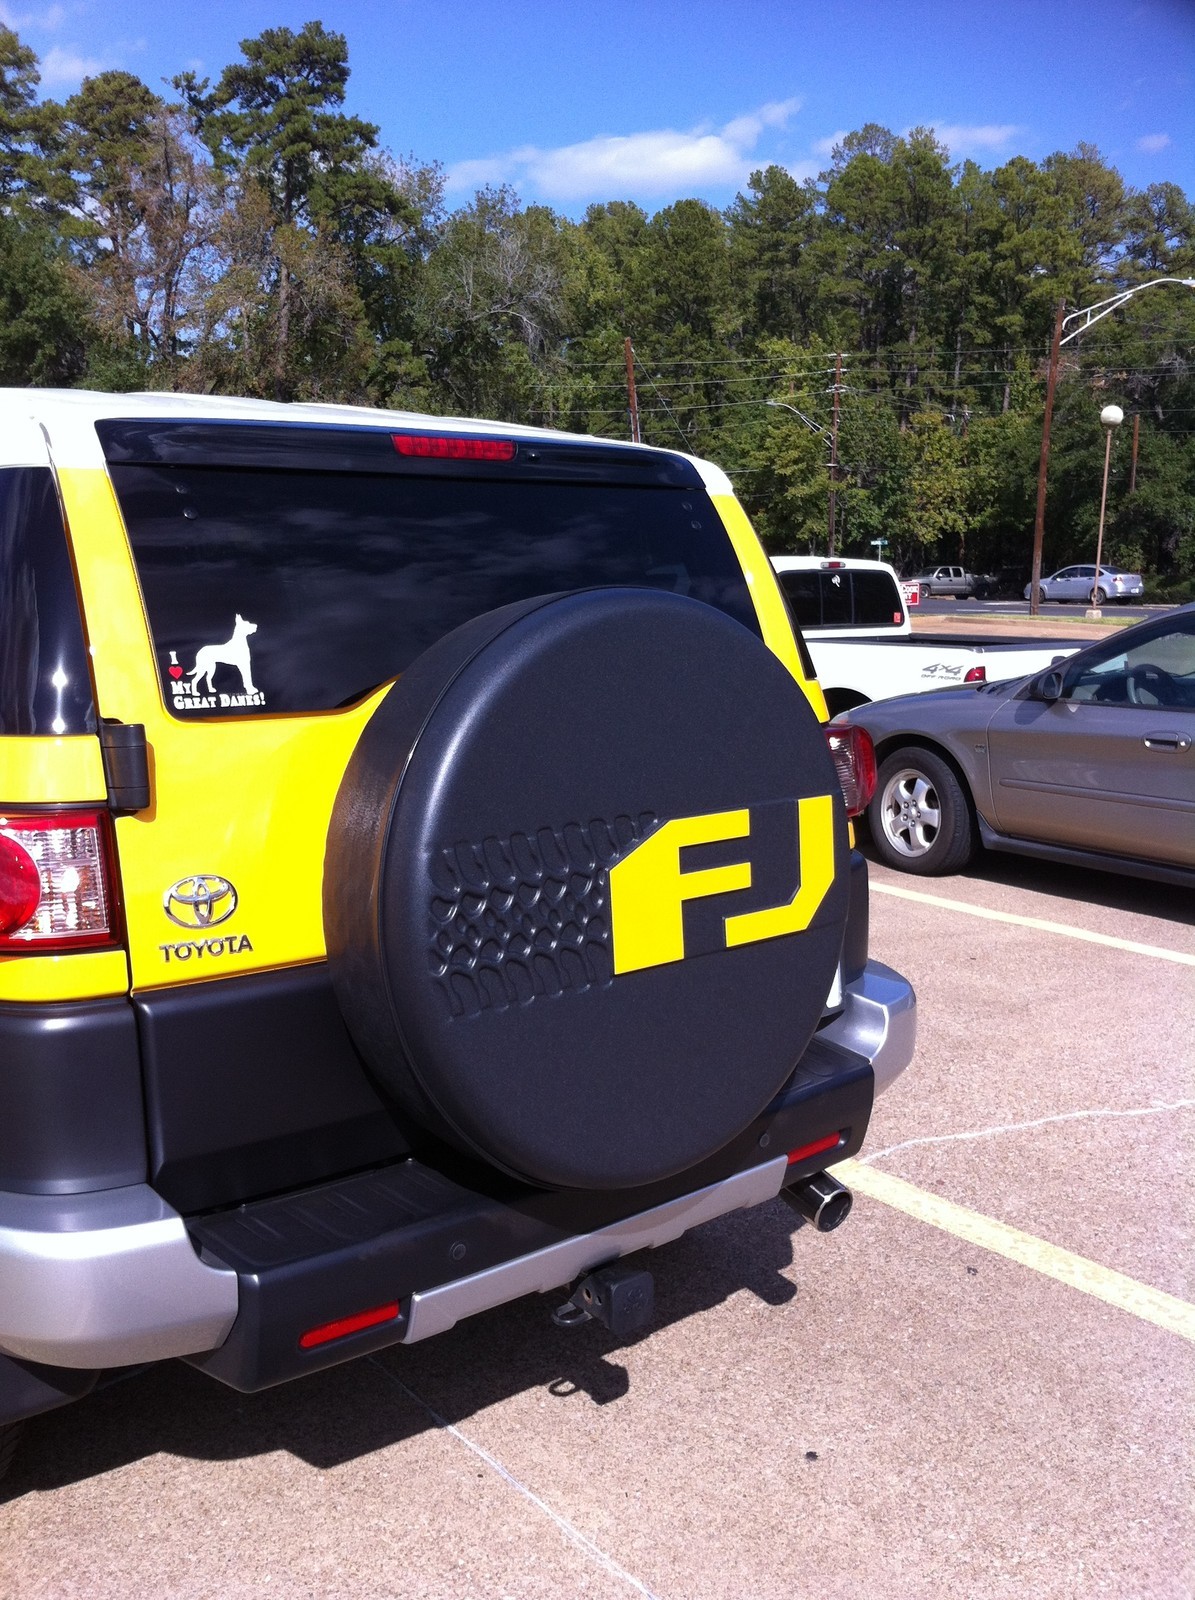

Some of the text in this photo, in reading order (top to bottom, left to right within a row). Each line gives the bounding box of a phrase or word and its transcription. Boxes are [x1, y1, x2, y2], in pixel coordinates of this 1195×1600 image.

[169, 651, 179, 665] I
[609, 794, 835, 975] FJ
[159, 935, 254, 963] TOYOTA
